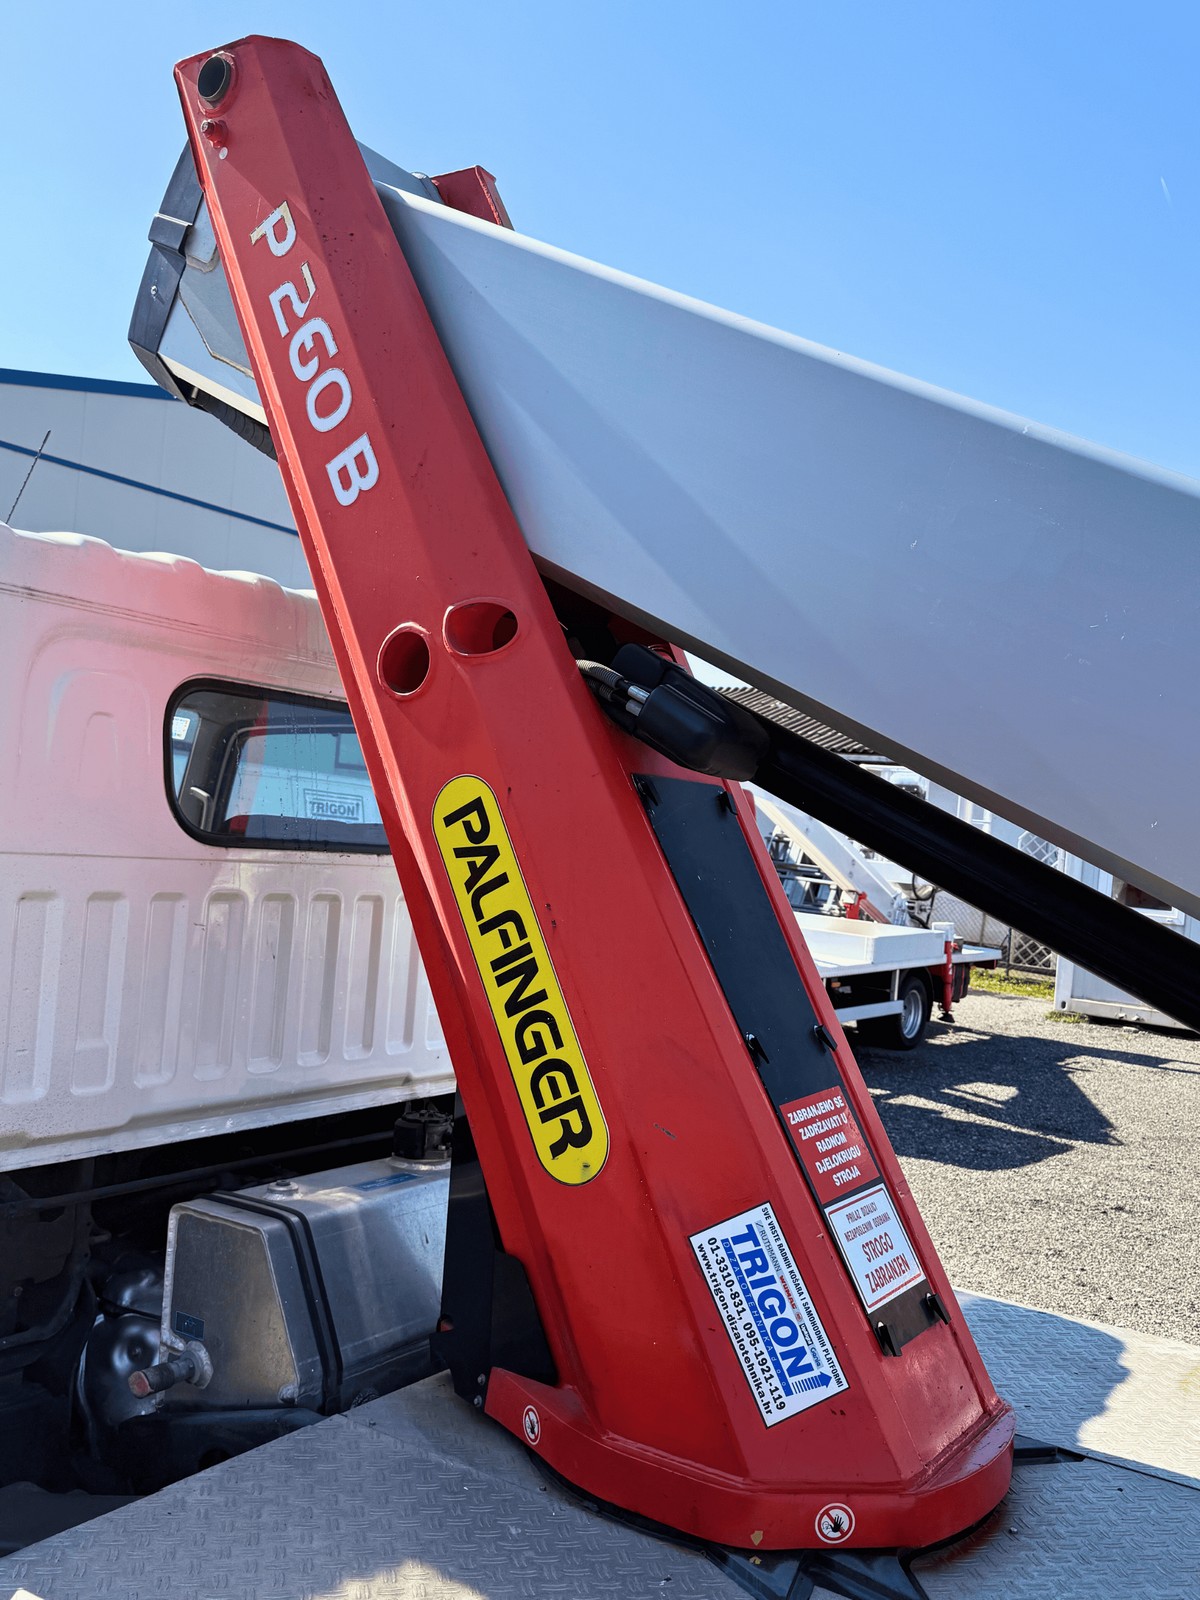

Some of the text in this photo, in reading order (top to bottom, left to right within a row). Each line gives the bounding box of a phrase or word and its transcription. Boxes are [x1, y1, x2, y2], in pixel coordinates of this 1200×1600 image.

[250, 201, 380, 506] P 260 B
[309, 800, 357, 817] TRIGON
[443, 796, 593, 1160] PALFINGER
[788, 1096, 844, 1124] ZABRANJENO SE
[799, 1113, 847, 1140] ZADRŽAVATI U
[816, 1132, 847, 1152] RADNOM
[816, 1145, 861, 1173] DJELOKRUGU
[833, 1165, 861, 1186] STROJA
[760, 1230, 781, 1272] RUTHMANN
[862, 1232, 893, 1262] STROGO
[865, 1253, 910, 1293] ZABRANJEN
[722, 1242, 773, 1351] DIZALOTEHNIKA
[731, 1224, 814, 1378] TRIGON
[761, 1207, 772, 1222] SVE
[768, 1221, 781, 1242] VRSTE
[777, 1243, 792, 1269] RADNIH
[789, 1270, 804, 1297] KOŠARA
[803, 1302, 826, 1347] SAMOHODNIH
[823, 1348, 843, 1387] PLATFORMI
[698, 1244, 772, 1414] www.trigon-dizalotehnika.hr
[708, 1238, 785, 1410] 01-3310-831, 095-1921-119
